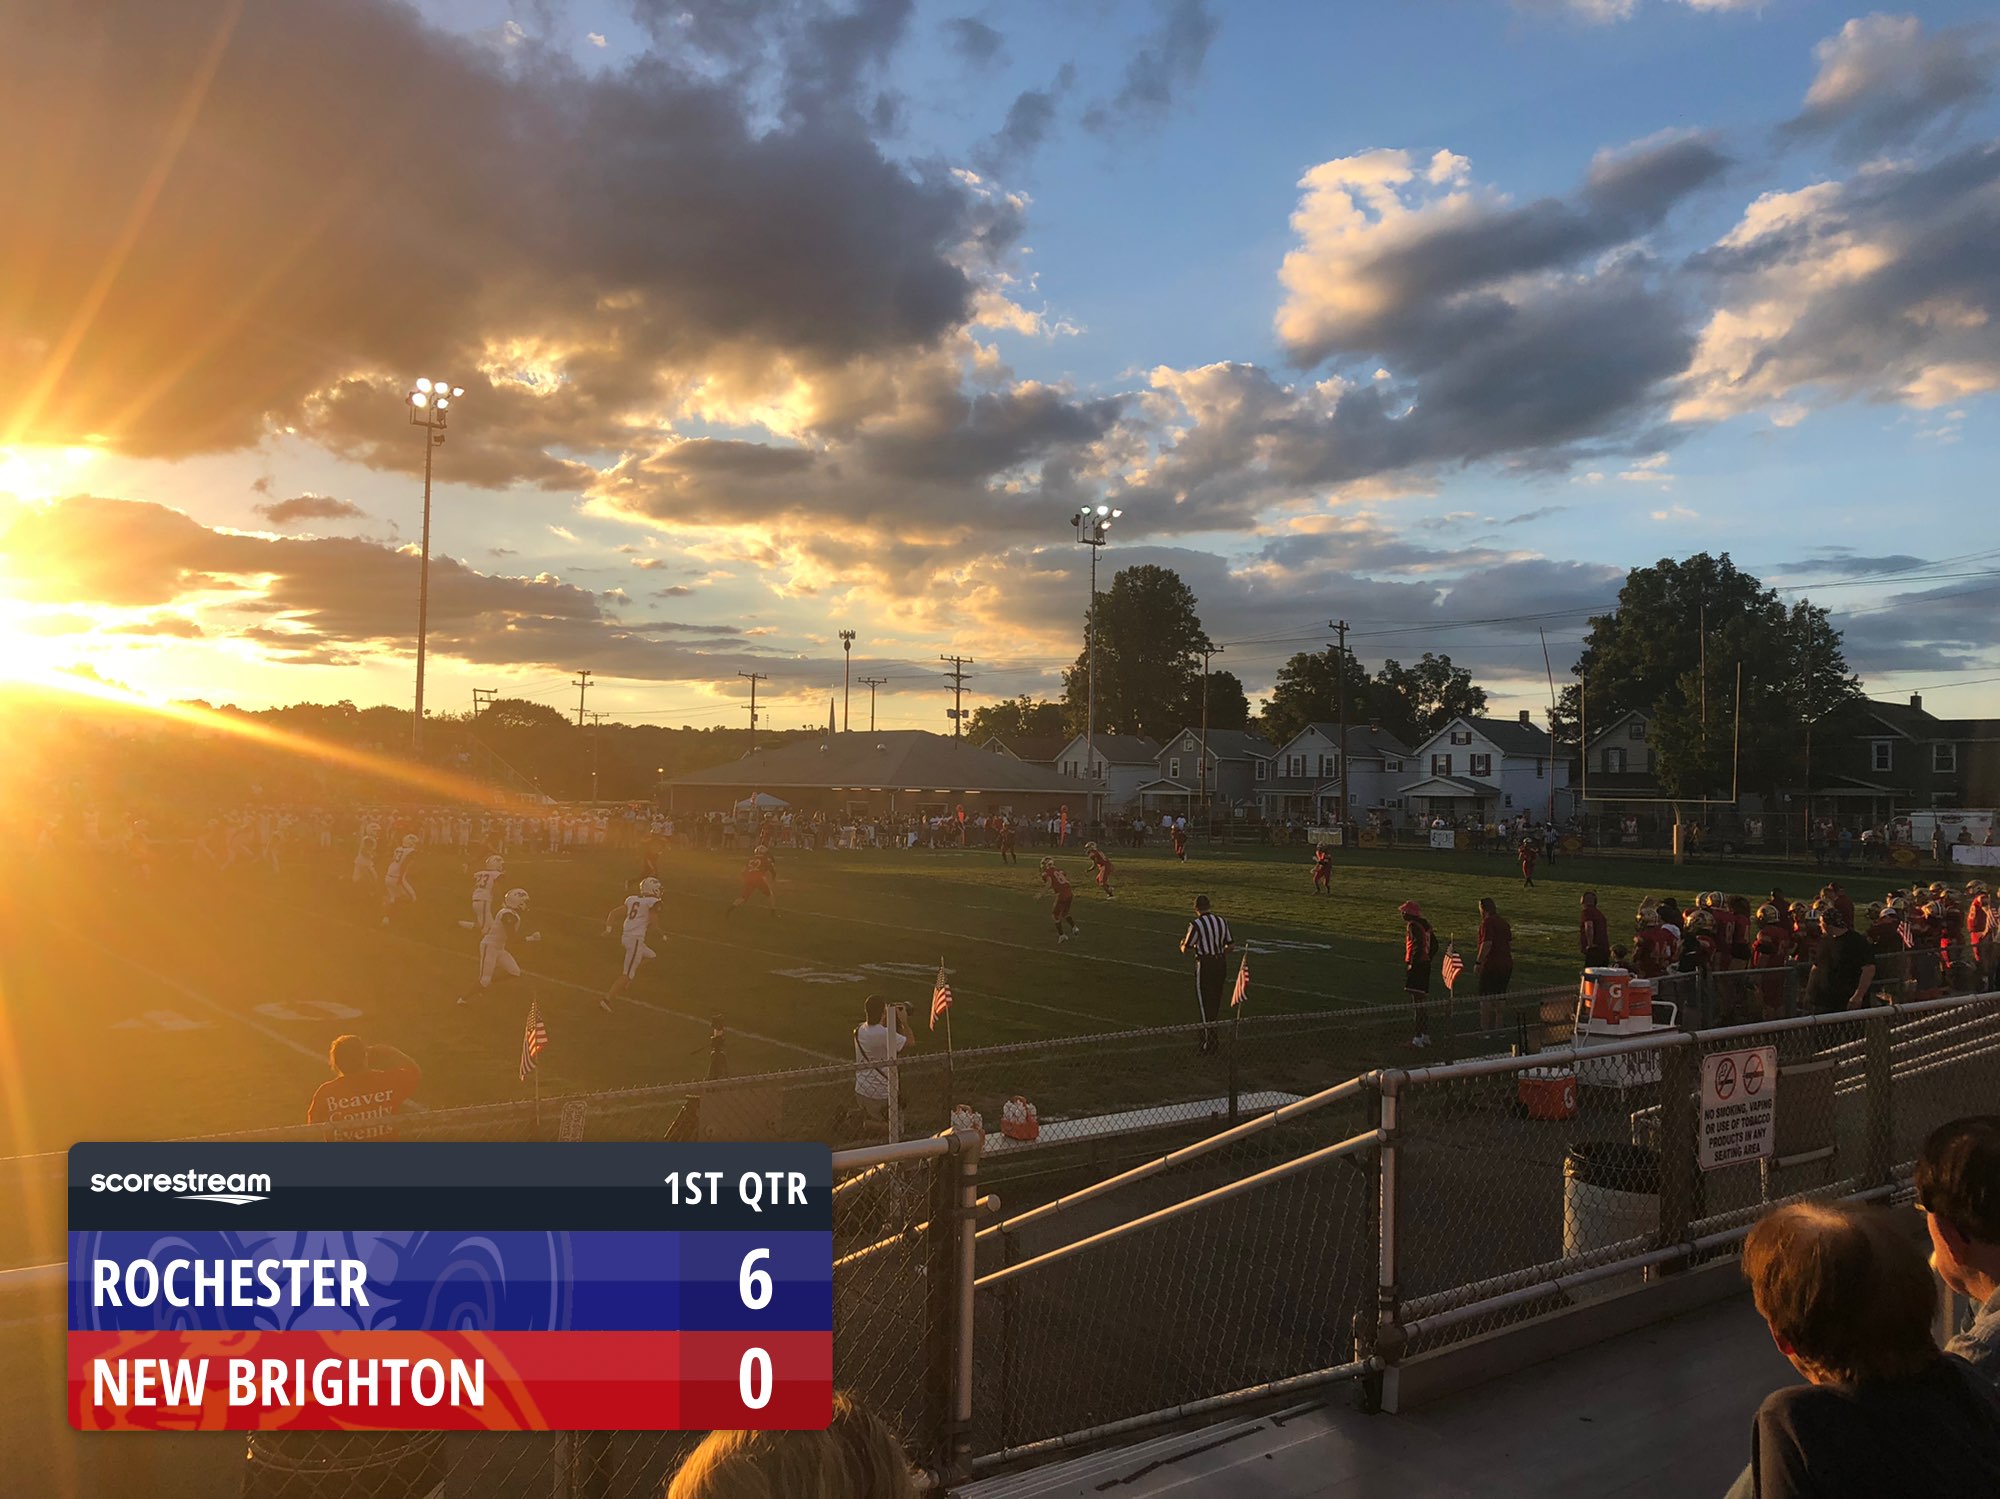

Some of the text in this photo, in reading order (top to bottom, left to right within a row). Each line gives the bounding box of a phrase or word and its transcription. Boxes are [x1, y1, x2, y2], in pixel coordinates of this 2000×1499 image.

[629, 901, 640, 920] 6
[1609, 984, 1622, 999] G
[326, 1089, 393, 1112] Beaver
[1704, 1098, 1772, 1120] NO SMOKING, VAPING
[1705, 1113, 1771, 1135] OR USE OF TOBACCO
[1709, 1128, 1767, 1148] PRODUCTS IN ANY
[1714, 1143, 1760, 1161] SEATING AREA
